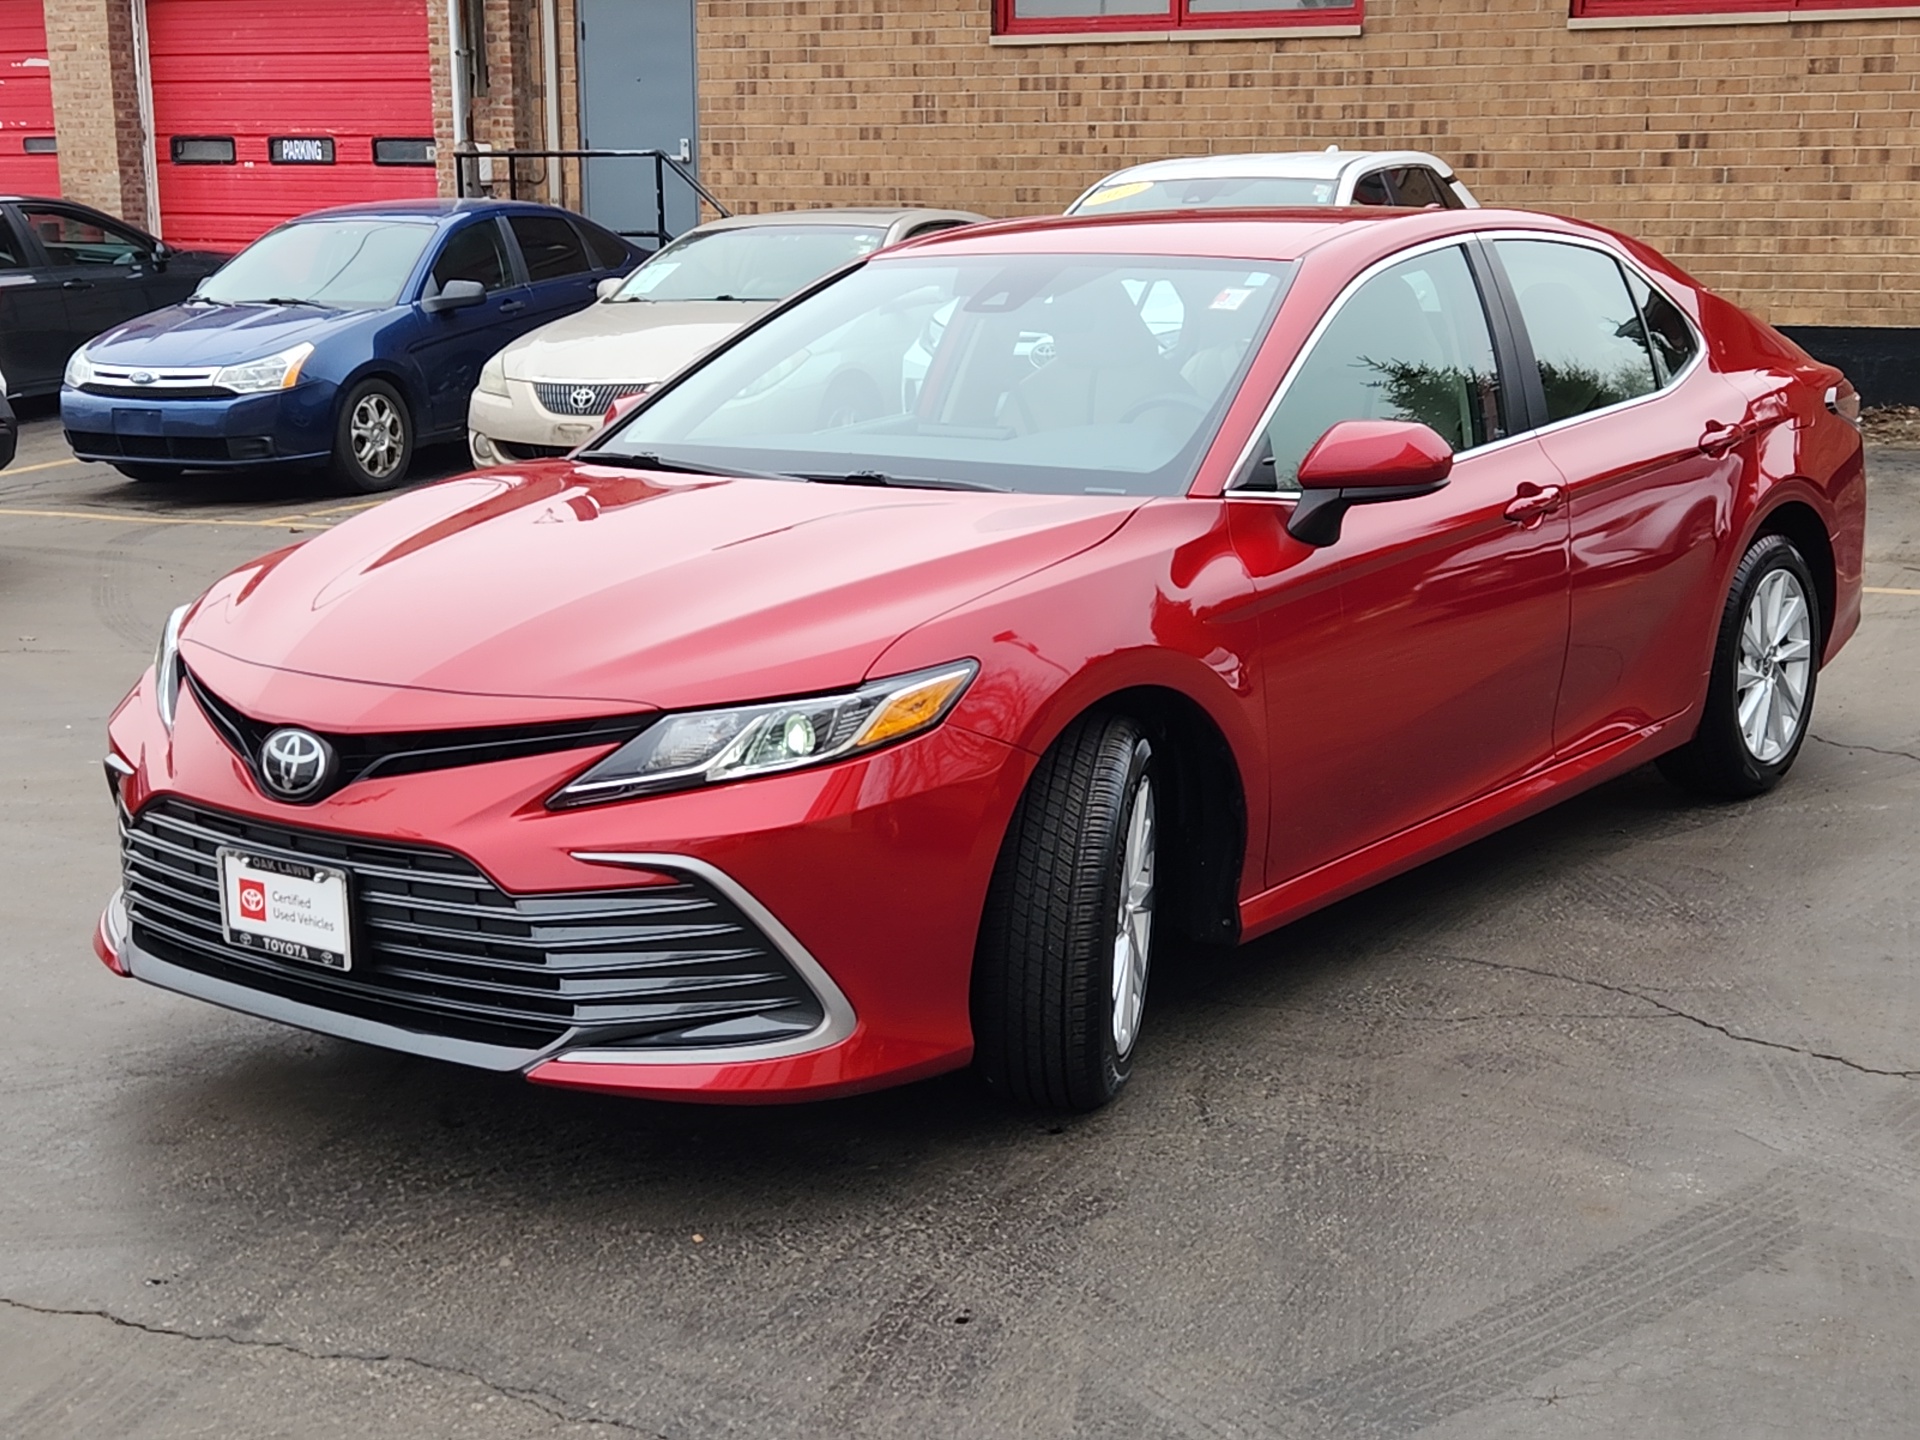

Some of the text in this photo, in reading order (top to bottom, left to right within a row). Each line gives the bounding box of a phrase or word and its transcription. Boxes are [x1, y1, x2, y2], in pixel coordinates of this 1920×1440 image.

[282, 140, 322, 160] PARKING
[253, 857, 311, 877] OAK LAWN
[272, 891, 311, 909] Certified
[273, 908, 334, 932] Used Vehicles
[263, 937, 309, 959] TOYOTA
